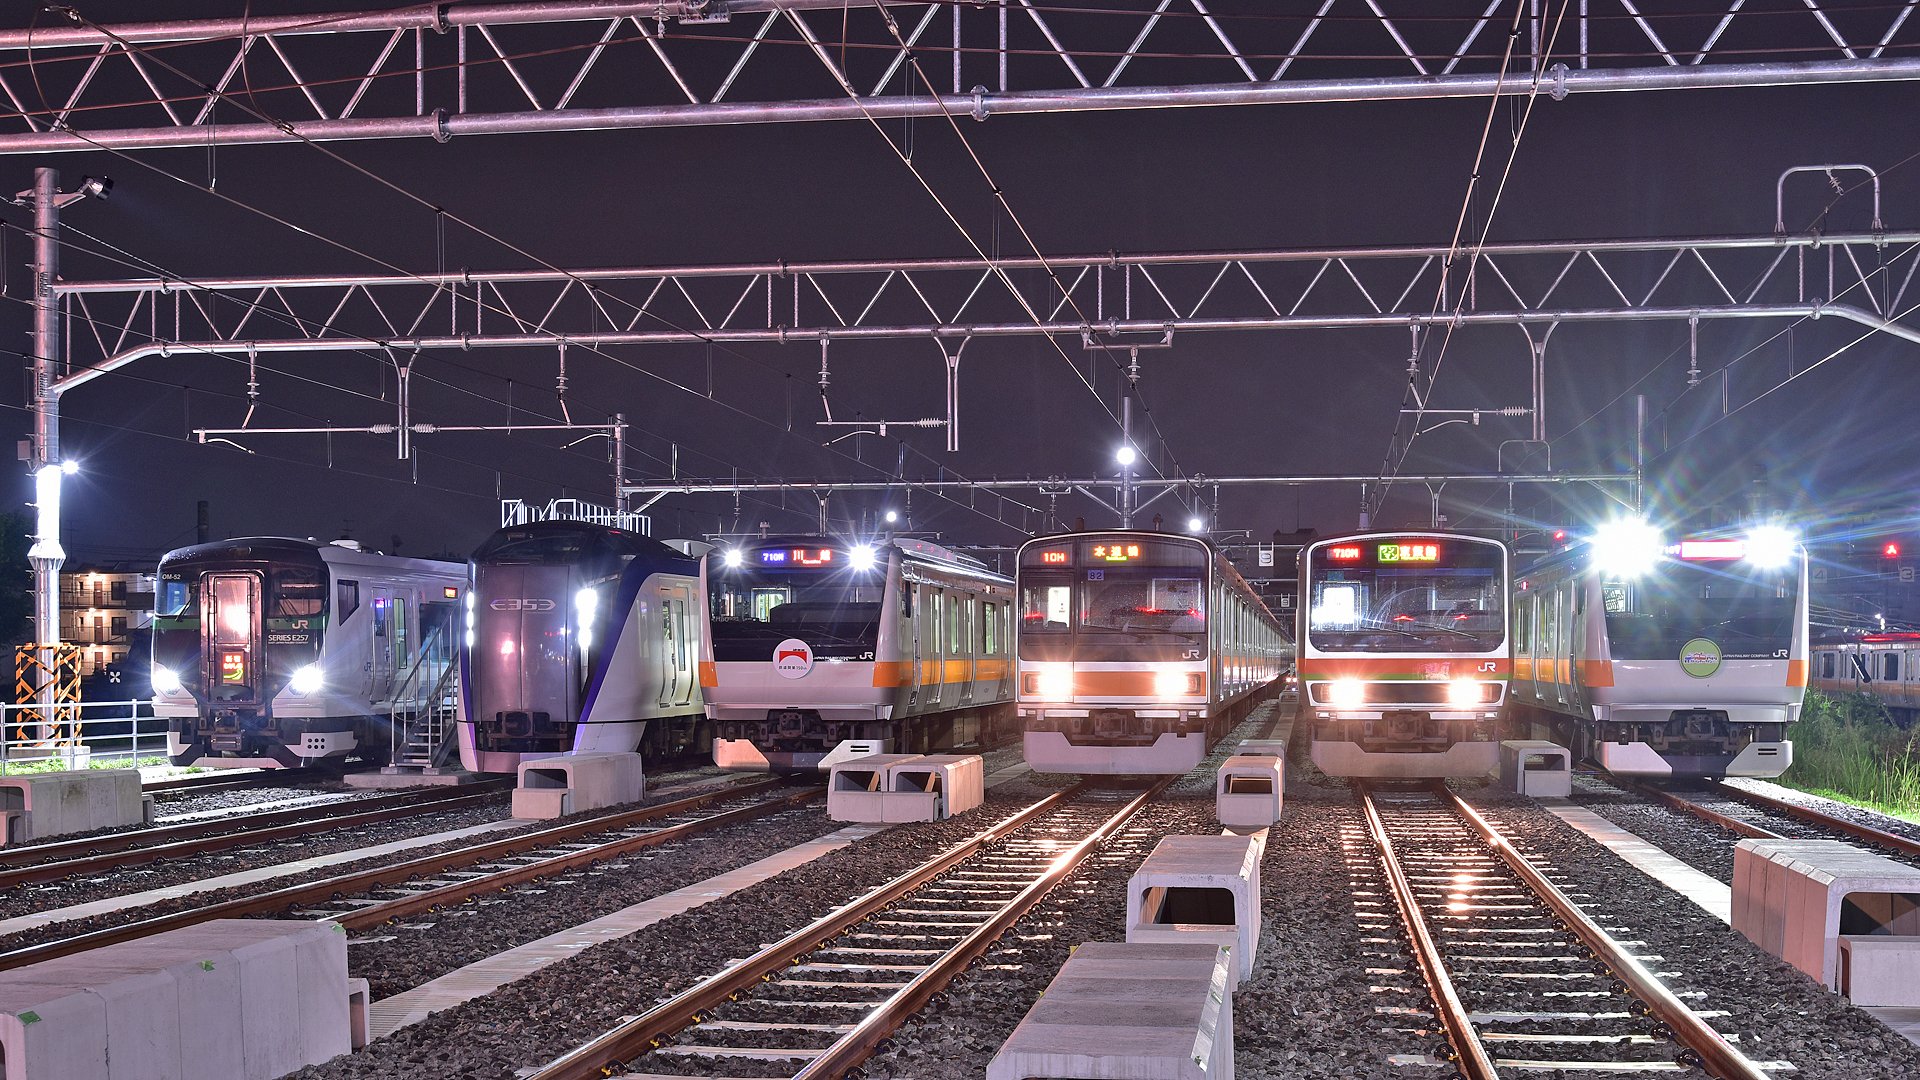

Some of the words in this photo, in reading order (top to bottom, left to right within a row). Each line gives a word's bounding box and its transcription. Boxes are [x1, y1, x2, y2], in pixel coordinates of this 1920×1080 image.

[1043, 552, 1065, 562] 10H
[291, 619, 309, 630] JR
[267, 634, 291, 642] SERIES
[292, 634, 309, 642] E257
[859, 651, 874, 660] JR
[1182, 649, 1200, 659] JR
[1772, 649, 1788, 658] JR
[1477, 661, 1496, 672] JR
